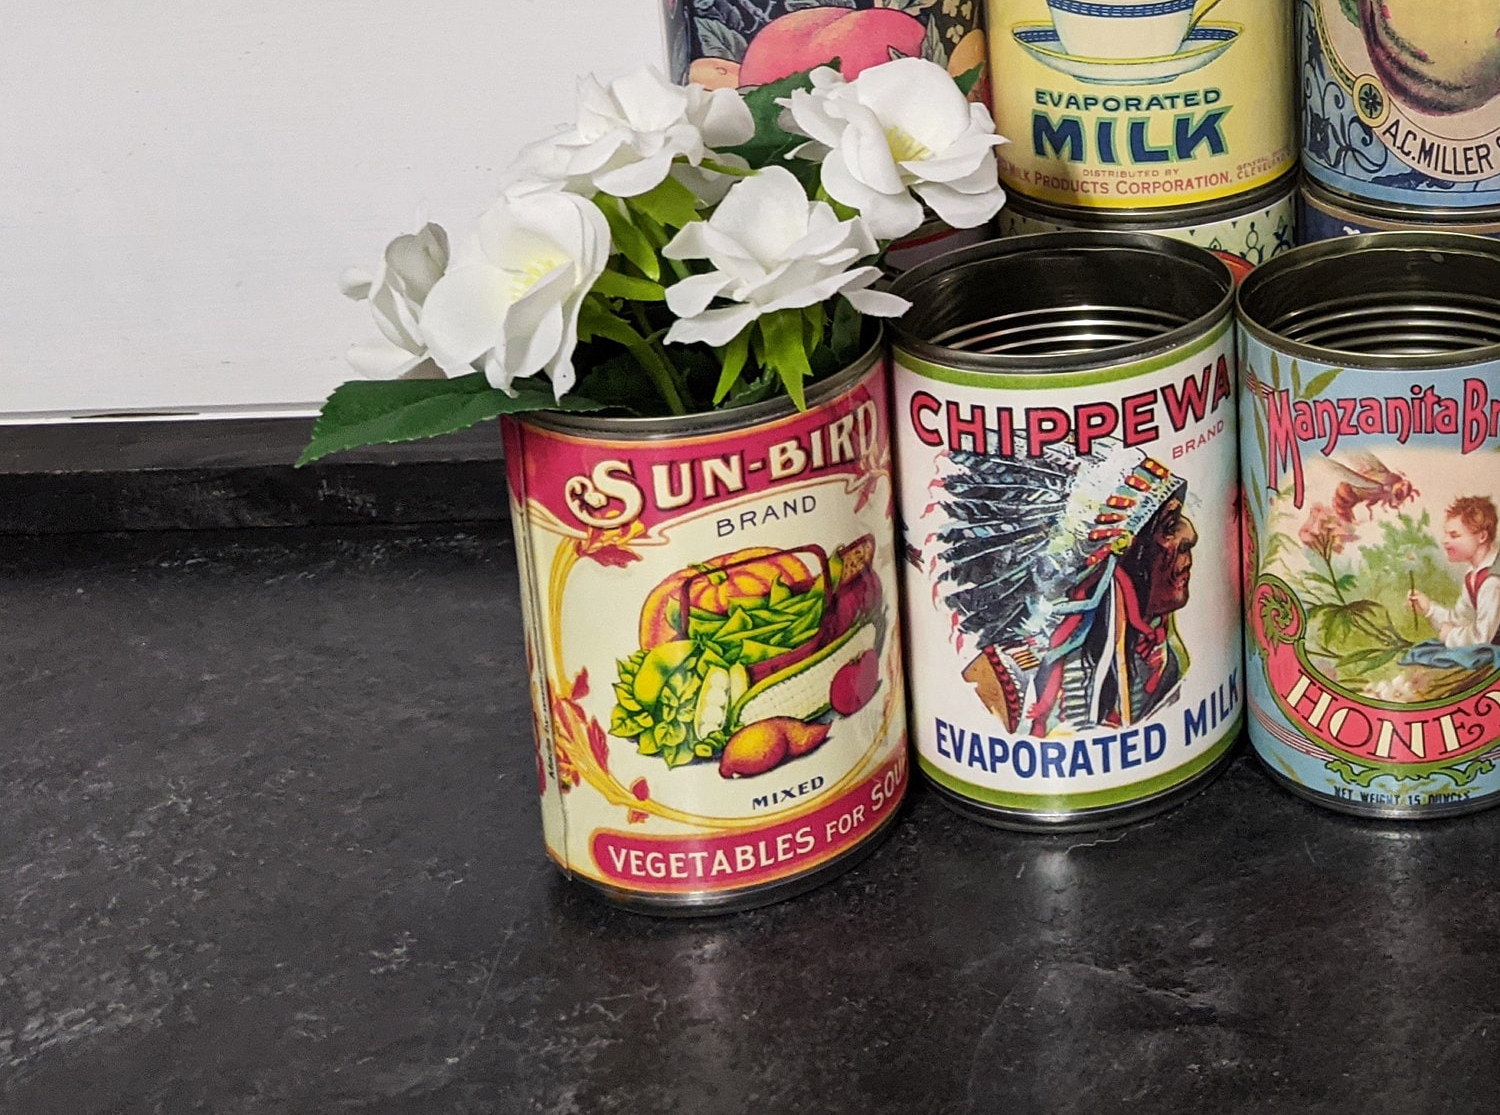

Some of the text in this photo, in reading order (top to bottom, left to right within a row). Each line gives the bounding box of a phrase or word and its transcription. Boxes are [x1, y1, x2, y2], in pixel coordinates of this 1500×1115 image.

[1035, 88, 1221, 113] EVAPORATED
[1031, 106, 1232, 165] MILK
[1034, 170, 1110, 195] PRODUCTS
[1083, 167, 1180, 179] DISTRIBUTED BY
[909, 355, 1232, 459] CHIPPEWA
[563, 399, 880, 530] SUN-BIRD
[1172, 419, 1225, 460] BRAND
[1266, 384, 1459, 508] Manzanita
[716, 494, 817, 538] BRAND
[935, 666, 1240, 780] EVAPORATED MILK
[751, 774, 826, 811] MIXED
[608, 825, 815, 880] VEGETABLES
[825, 808, 866, 845] FOR
